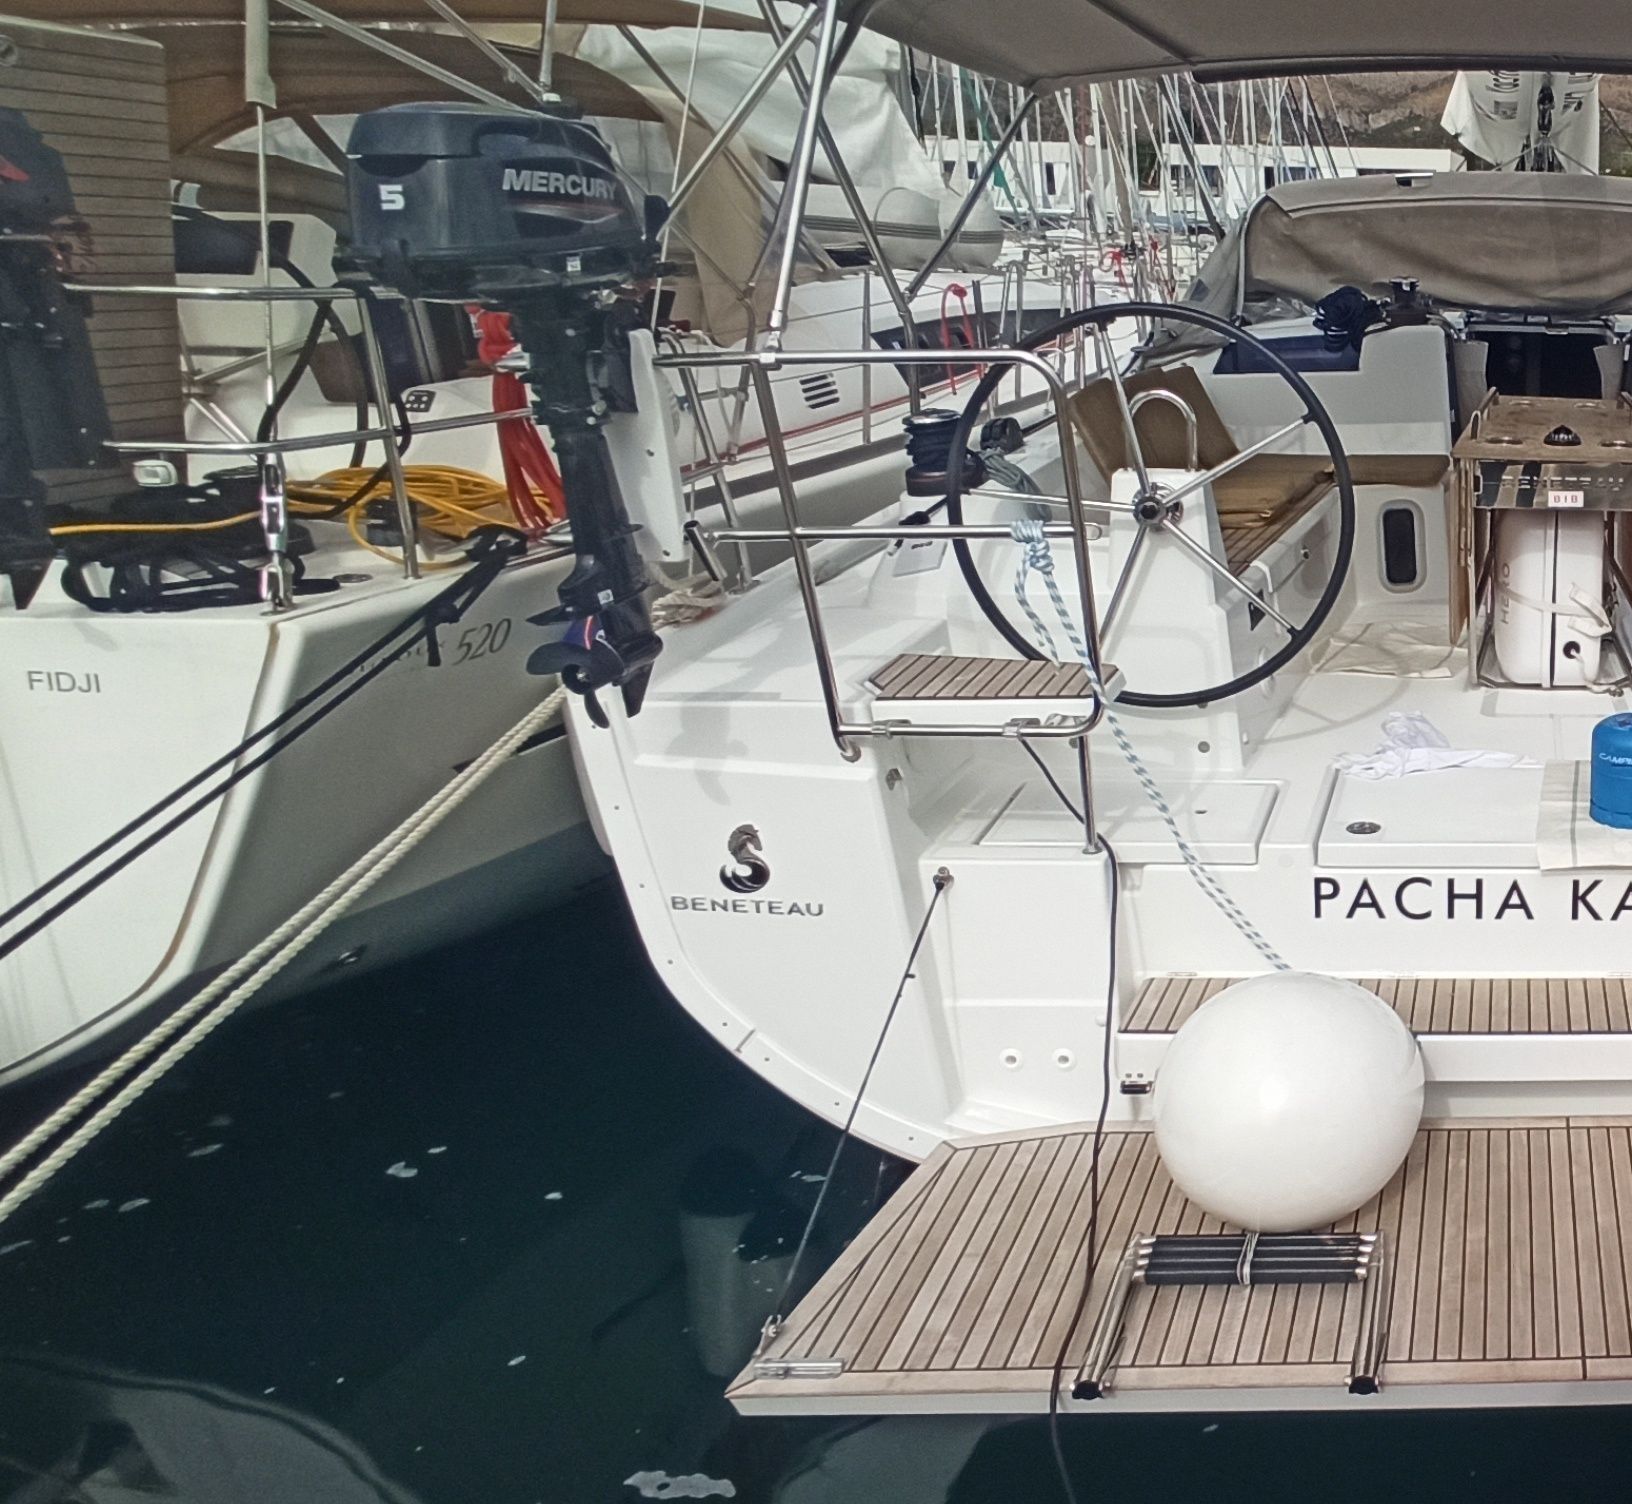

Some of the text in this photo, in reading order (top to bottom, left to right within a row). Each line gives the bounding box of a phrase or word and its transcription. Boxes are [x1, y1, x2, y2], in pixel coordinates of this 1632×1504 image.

[378, 184, 405, 210] 5
[502, 168, 618, 200] MERCURY
[452, 618, 512, 665] 520
[27, 670, 101, 693] FIDJI
[671, 896, 824, 917] BENETEAU
[1313, 876, 1535, 921] PACHA
